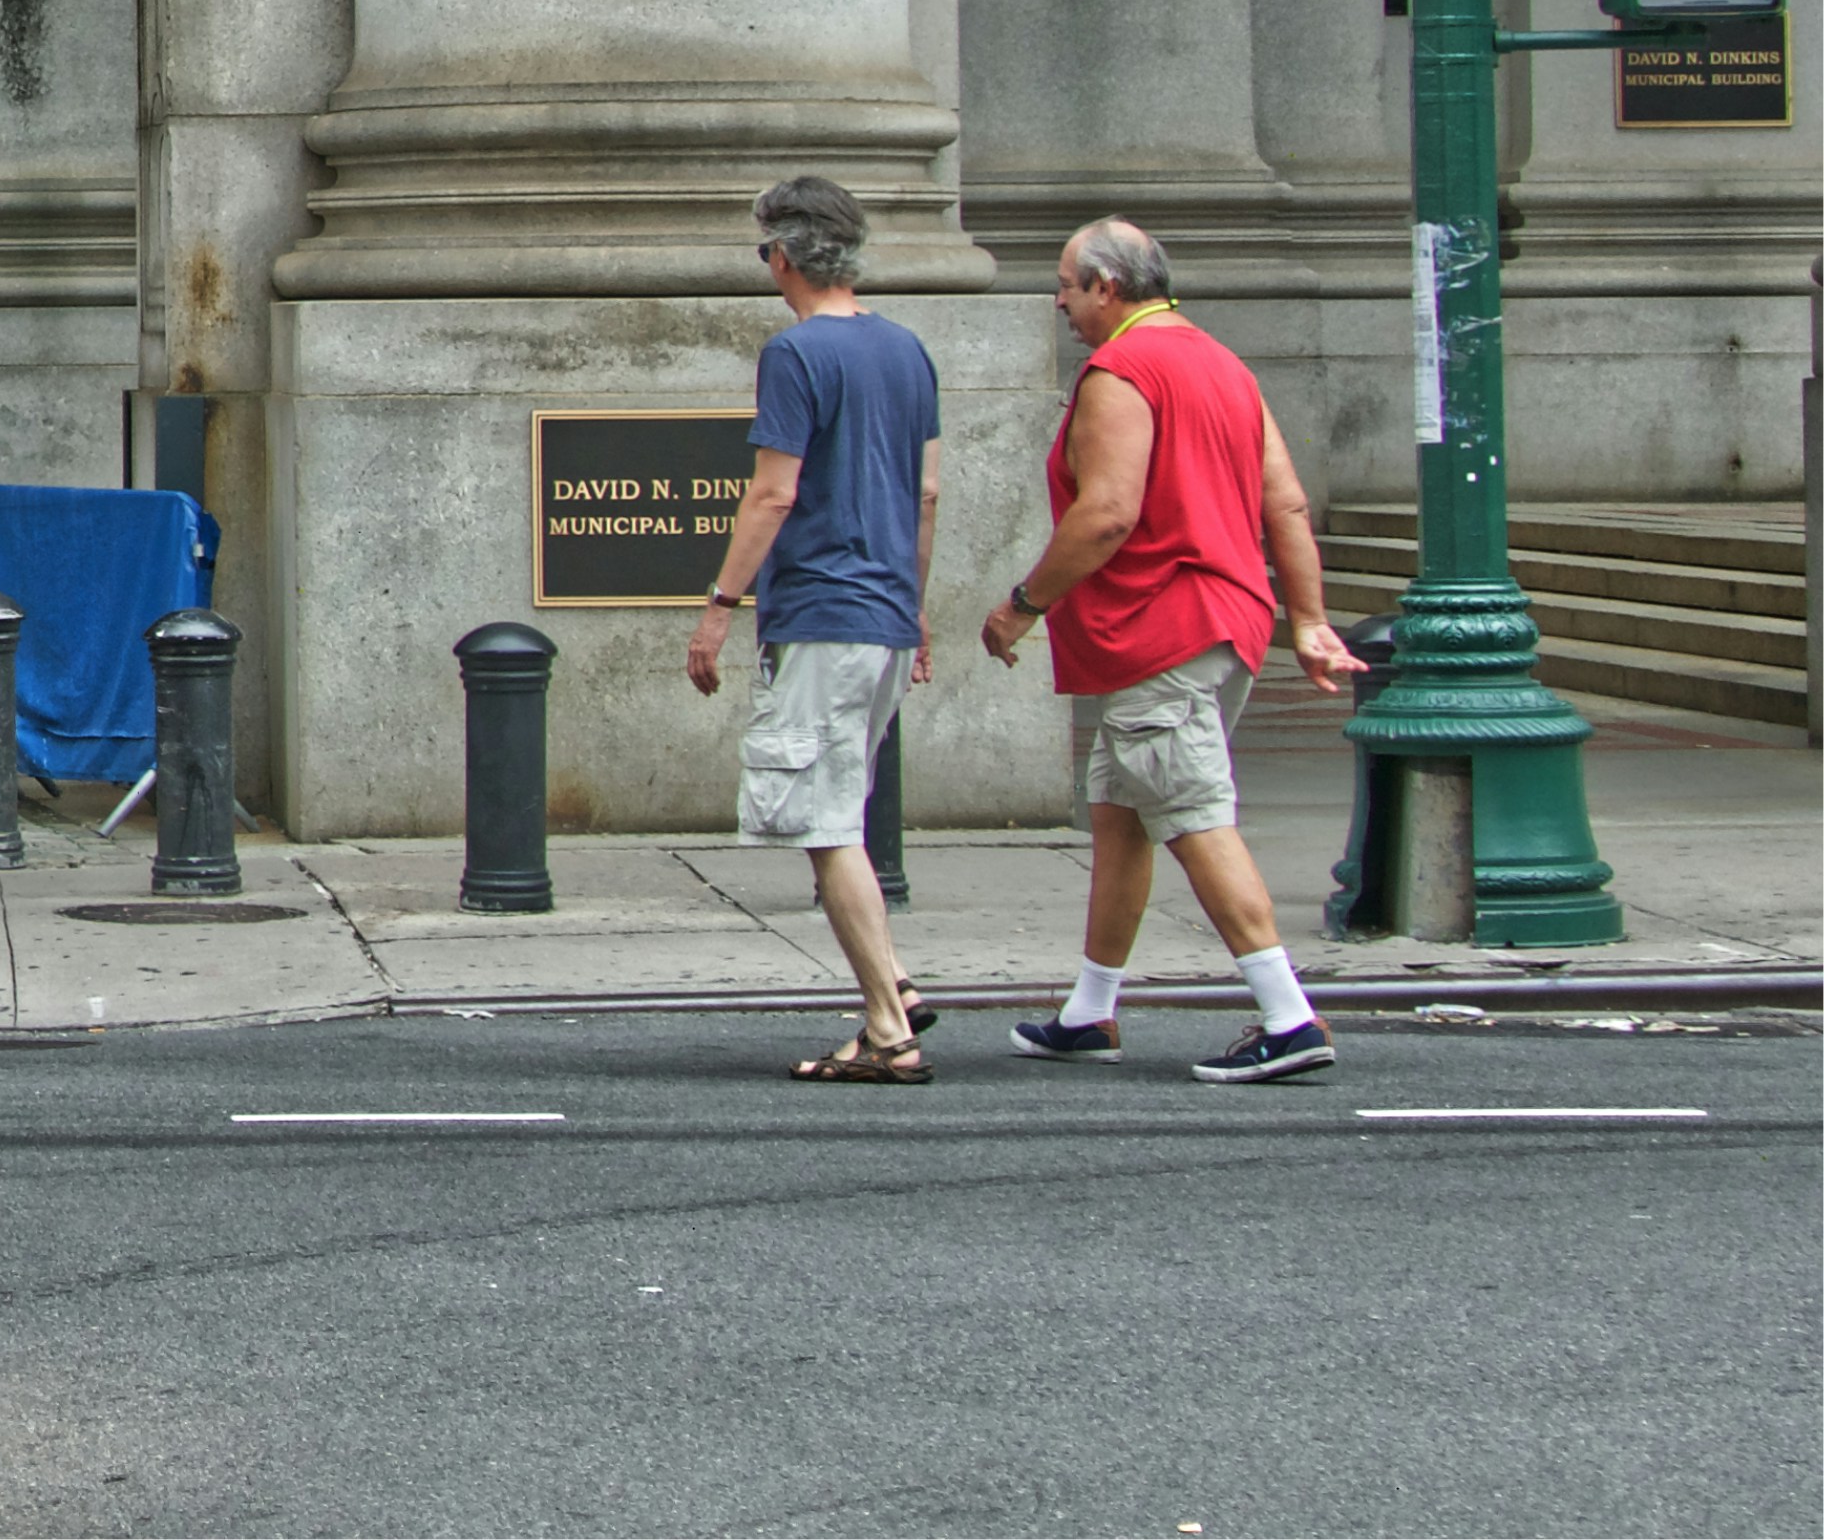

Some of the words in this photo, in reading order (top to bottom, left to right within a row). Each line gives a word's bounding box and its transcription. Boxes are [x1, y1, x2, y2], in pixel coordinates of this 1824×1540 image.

[1627, 51, 1680, 66] DAVID
[1686, 51, 1703, 66] N.
[1709, 50, 1781, 65] DINKINS
[1625, 73, 1706, 87] MUNICIPAL
[1711, 73, 1782, 86] BUILDING
[553, 479, 642, 501] DAVID
[651, 478, 680, 501] N.
[549, 516, 685, 536] MUNICIPAL
